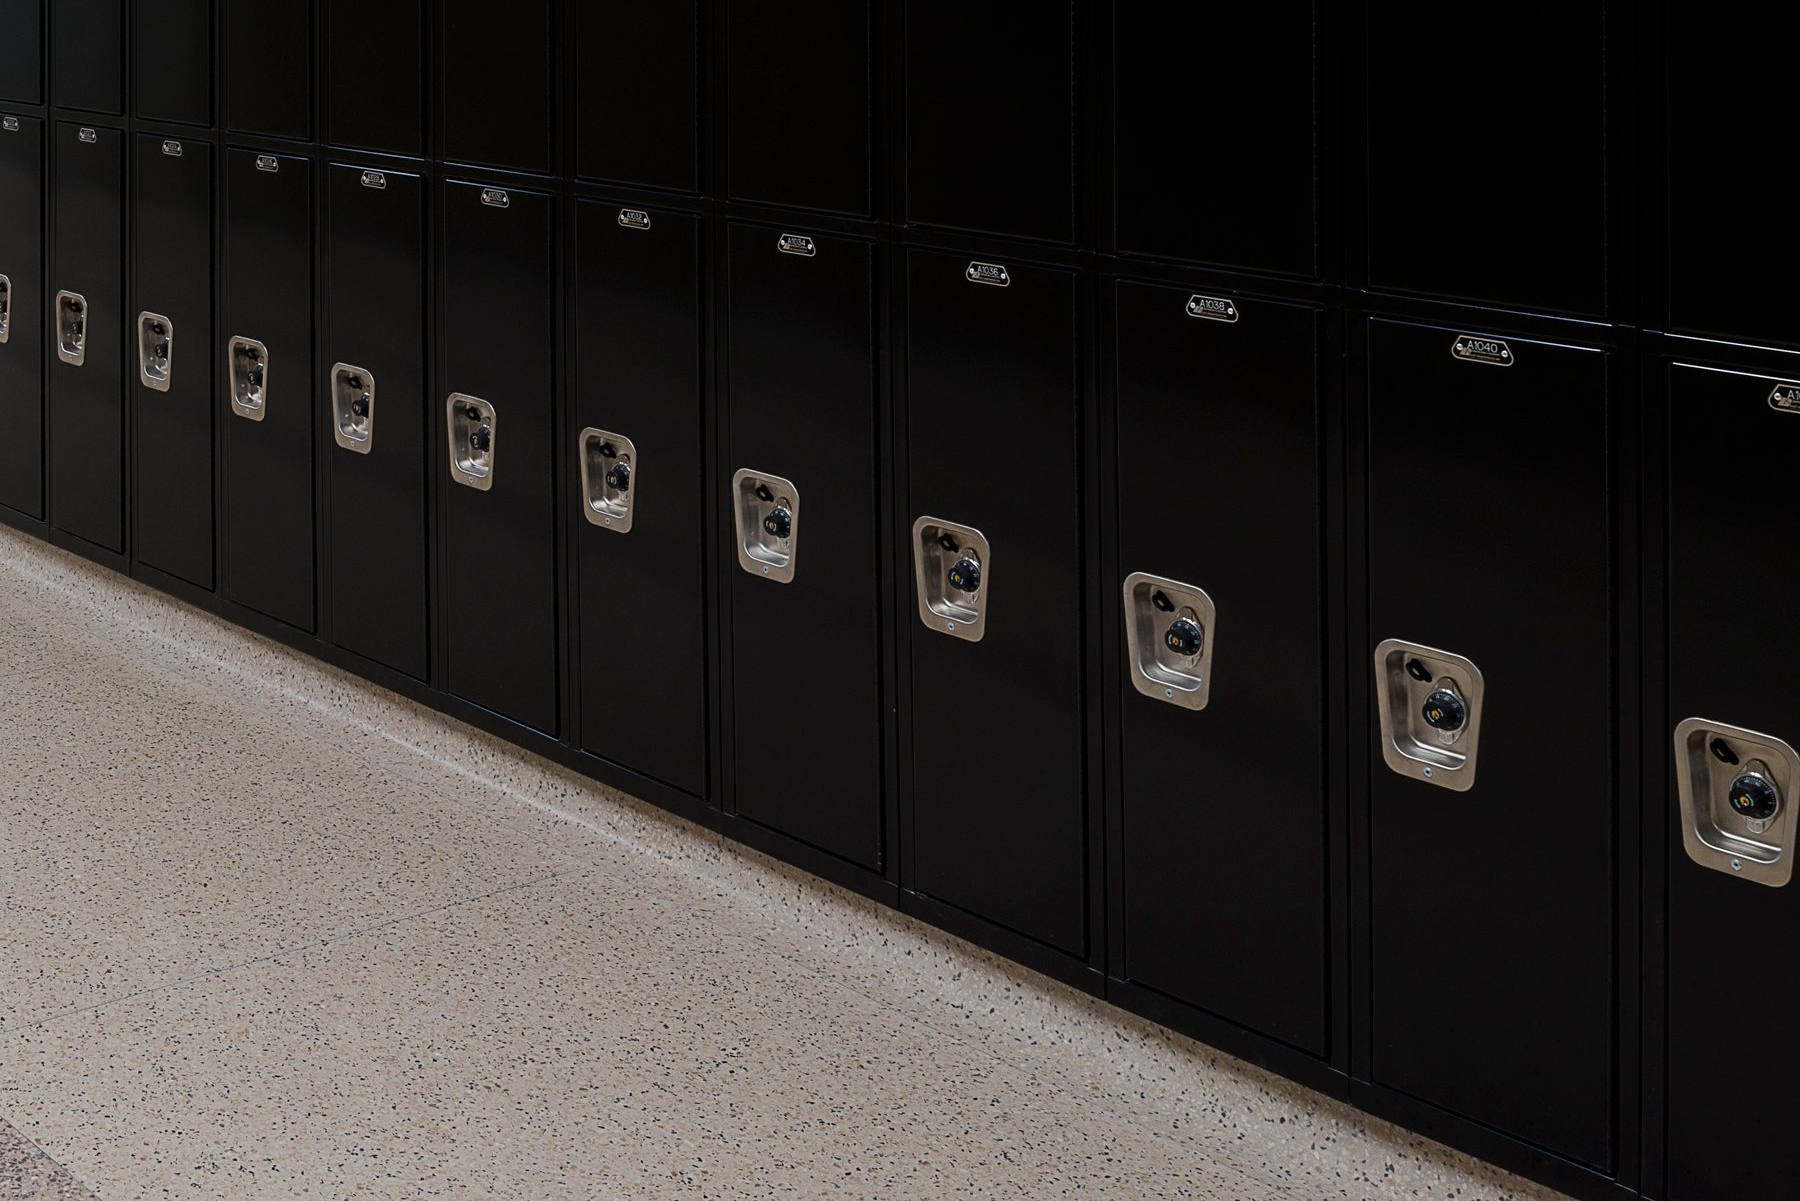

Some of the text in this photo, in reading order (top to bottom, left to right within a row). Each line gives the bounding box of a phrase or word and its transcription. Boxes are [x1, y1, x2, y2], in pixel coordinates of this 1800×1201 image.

[787, 238, 806, 246] A1034
[977, 265, 999, 276] A1036
[1199, 299, 1225, 311] A1038
[1467, 340, 1498, 353] A1040
